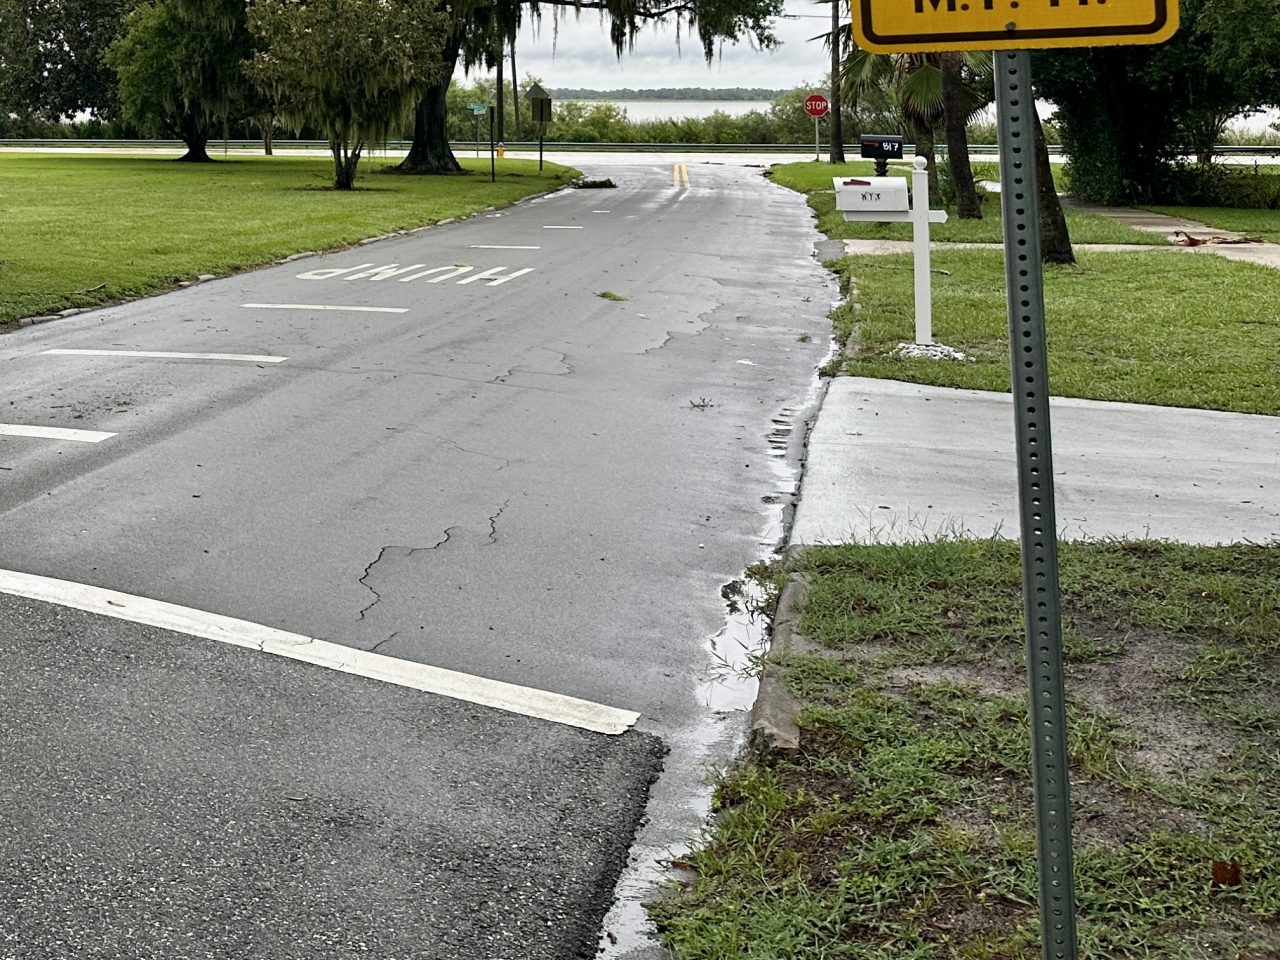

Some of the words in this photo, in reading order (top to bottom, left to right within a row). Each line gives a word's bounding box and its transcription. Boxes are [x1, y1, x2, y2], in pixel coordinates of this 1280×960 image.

[806, 101, 827, 110] STOP
[882, 141, 899, 152] 817
[295, 263, 536, 287] HUMP
